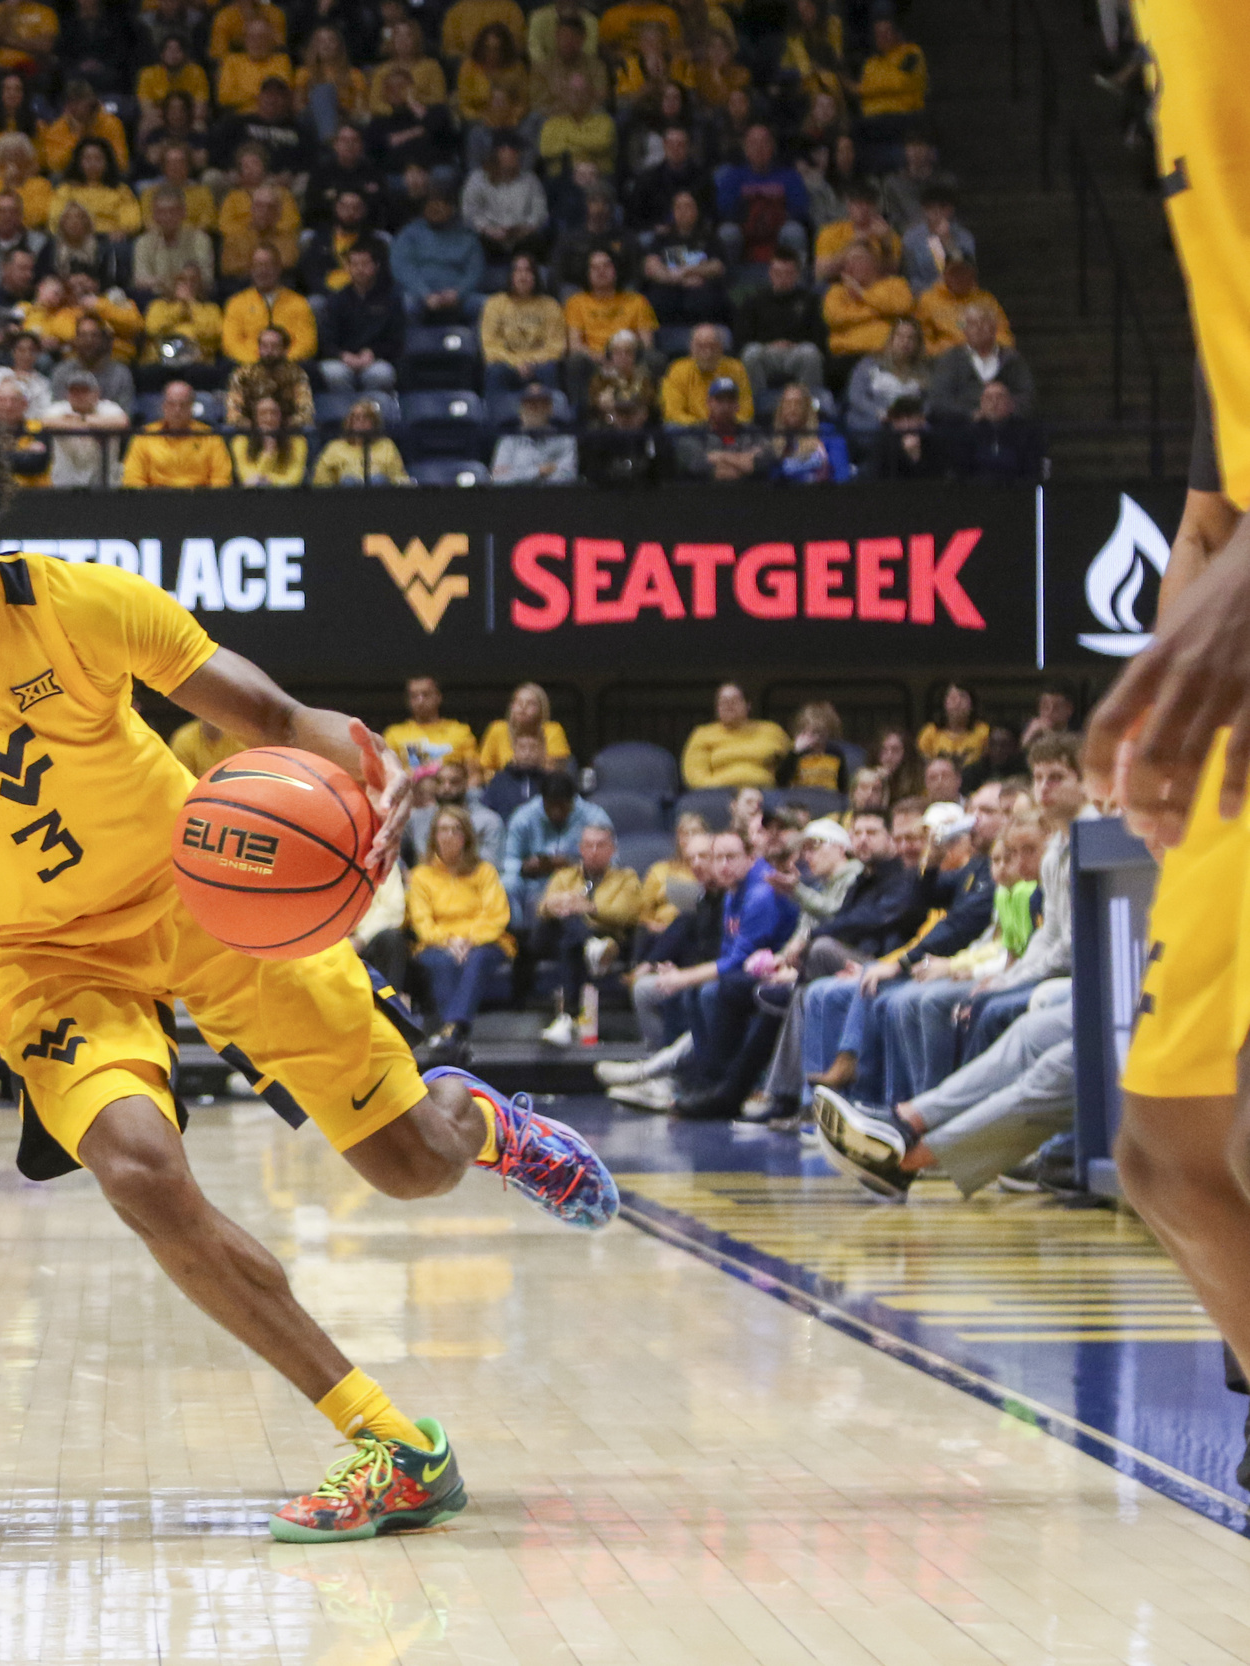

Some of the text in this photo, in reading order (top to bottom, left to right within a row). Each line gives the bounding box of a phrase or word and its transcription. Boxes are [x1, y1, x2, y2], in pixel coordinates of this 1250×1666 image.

[510, 527, 987, 633] SEATGEEK
[11, 808, 84, 883] 3
[182, 817, 280, 868] ELITE
